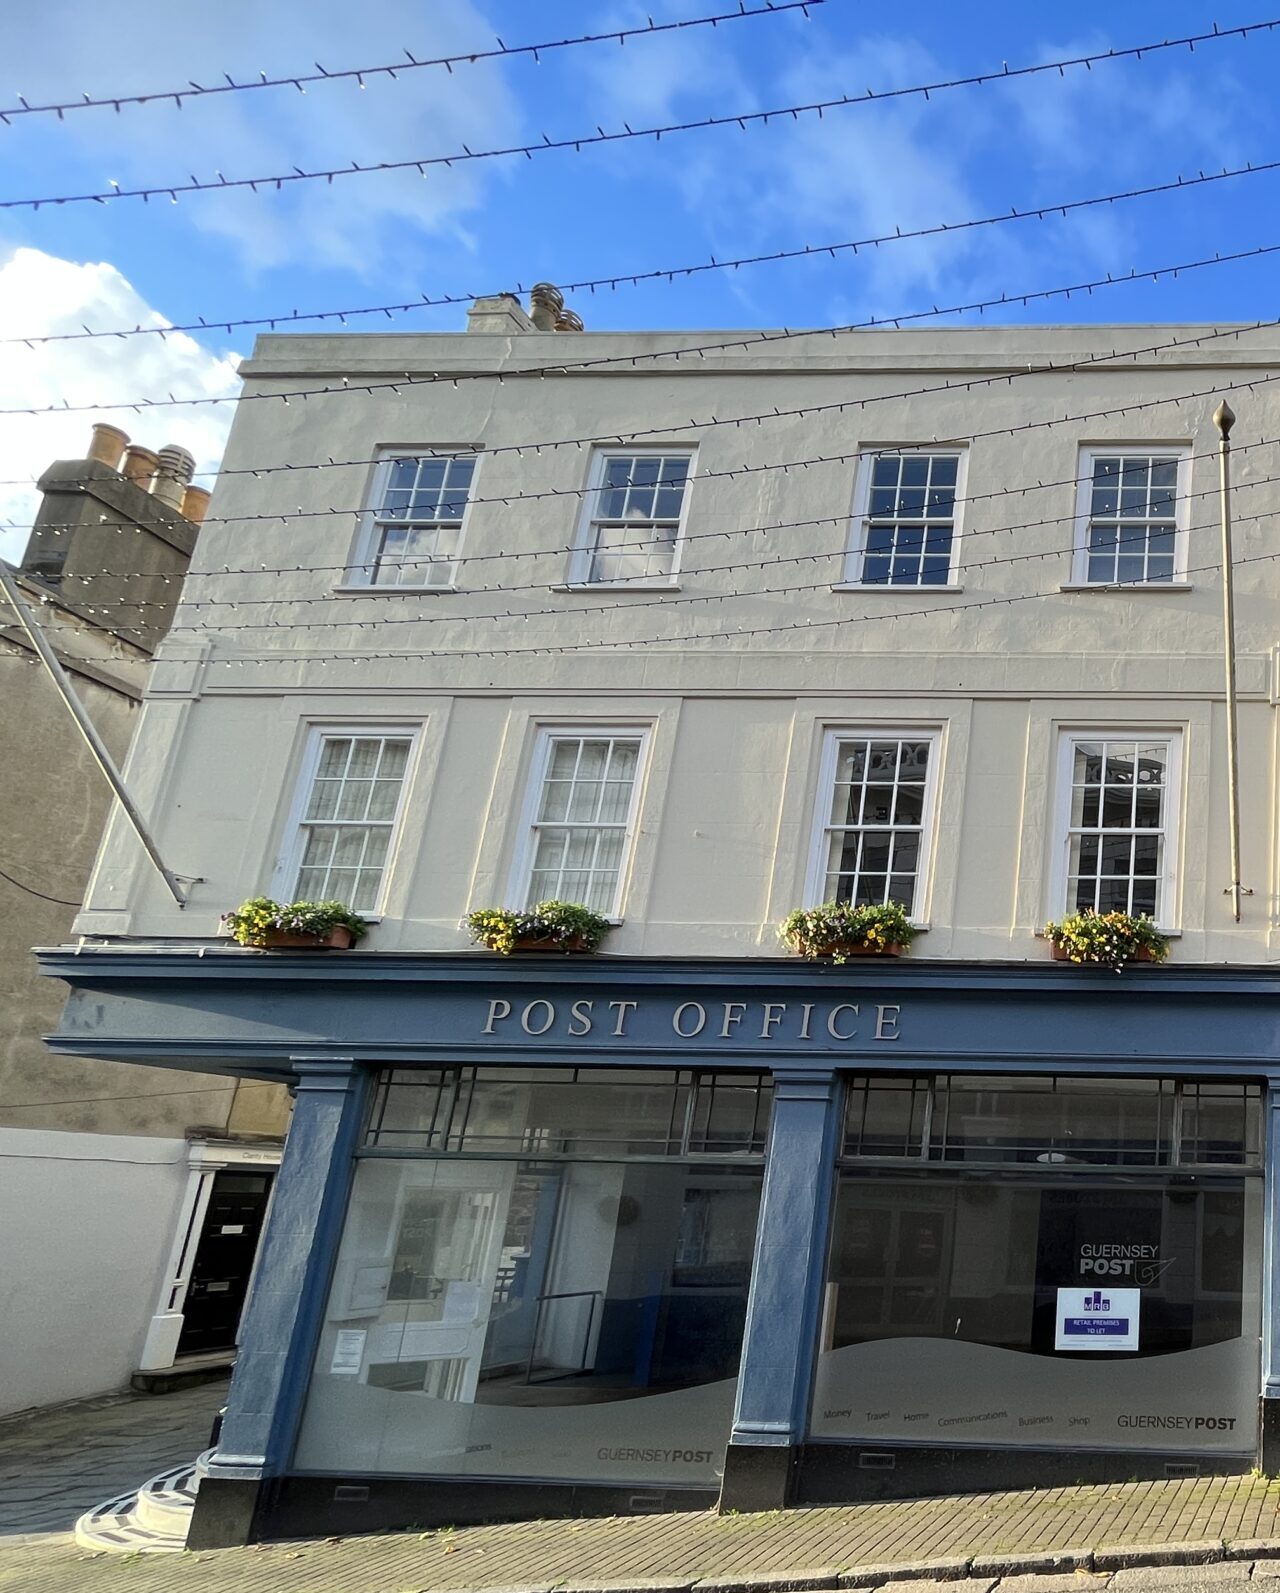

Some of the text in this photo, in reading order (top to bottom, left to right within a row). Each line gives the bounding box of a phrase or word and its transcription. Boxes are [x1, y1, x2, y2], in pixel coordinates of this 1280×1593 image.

[481, 1000, 901, 1040] POST OFFICE
[1080, 1244, 1158, 1257] GUERNSEY
[1080, 1259, 1134, 1275] POST
[823, 1409, 1091, 1427] Money Travel Home Communications Business Shop
